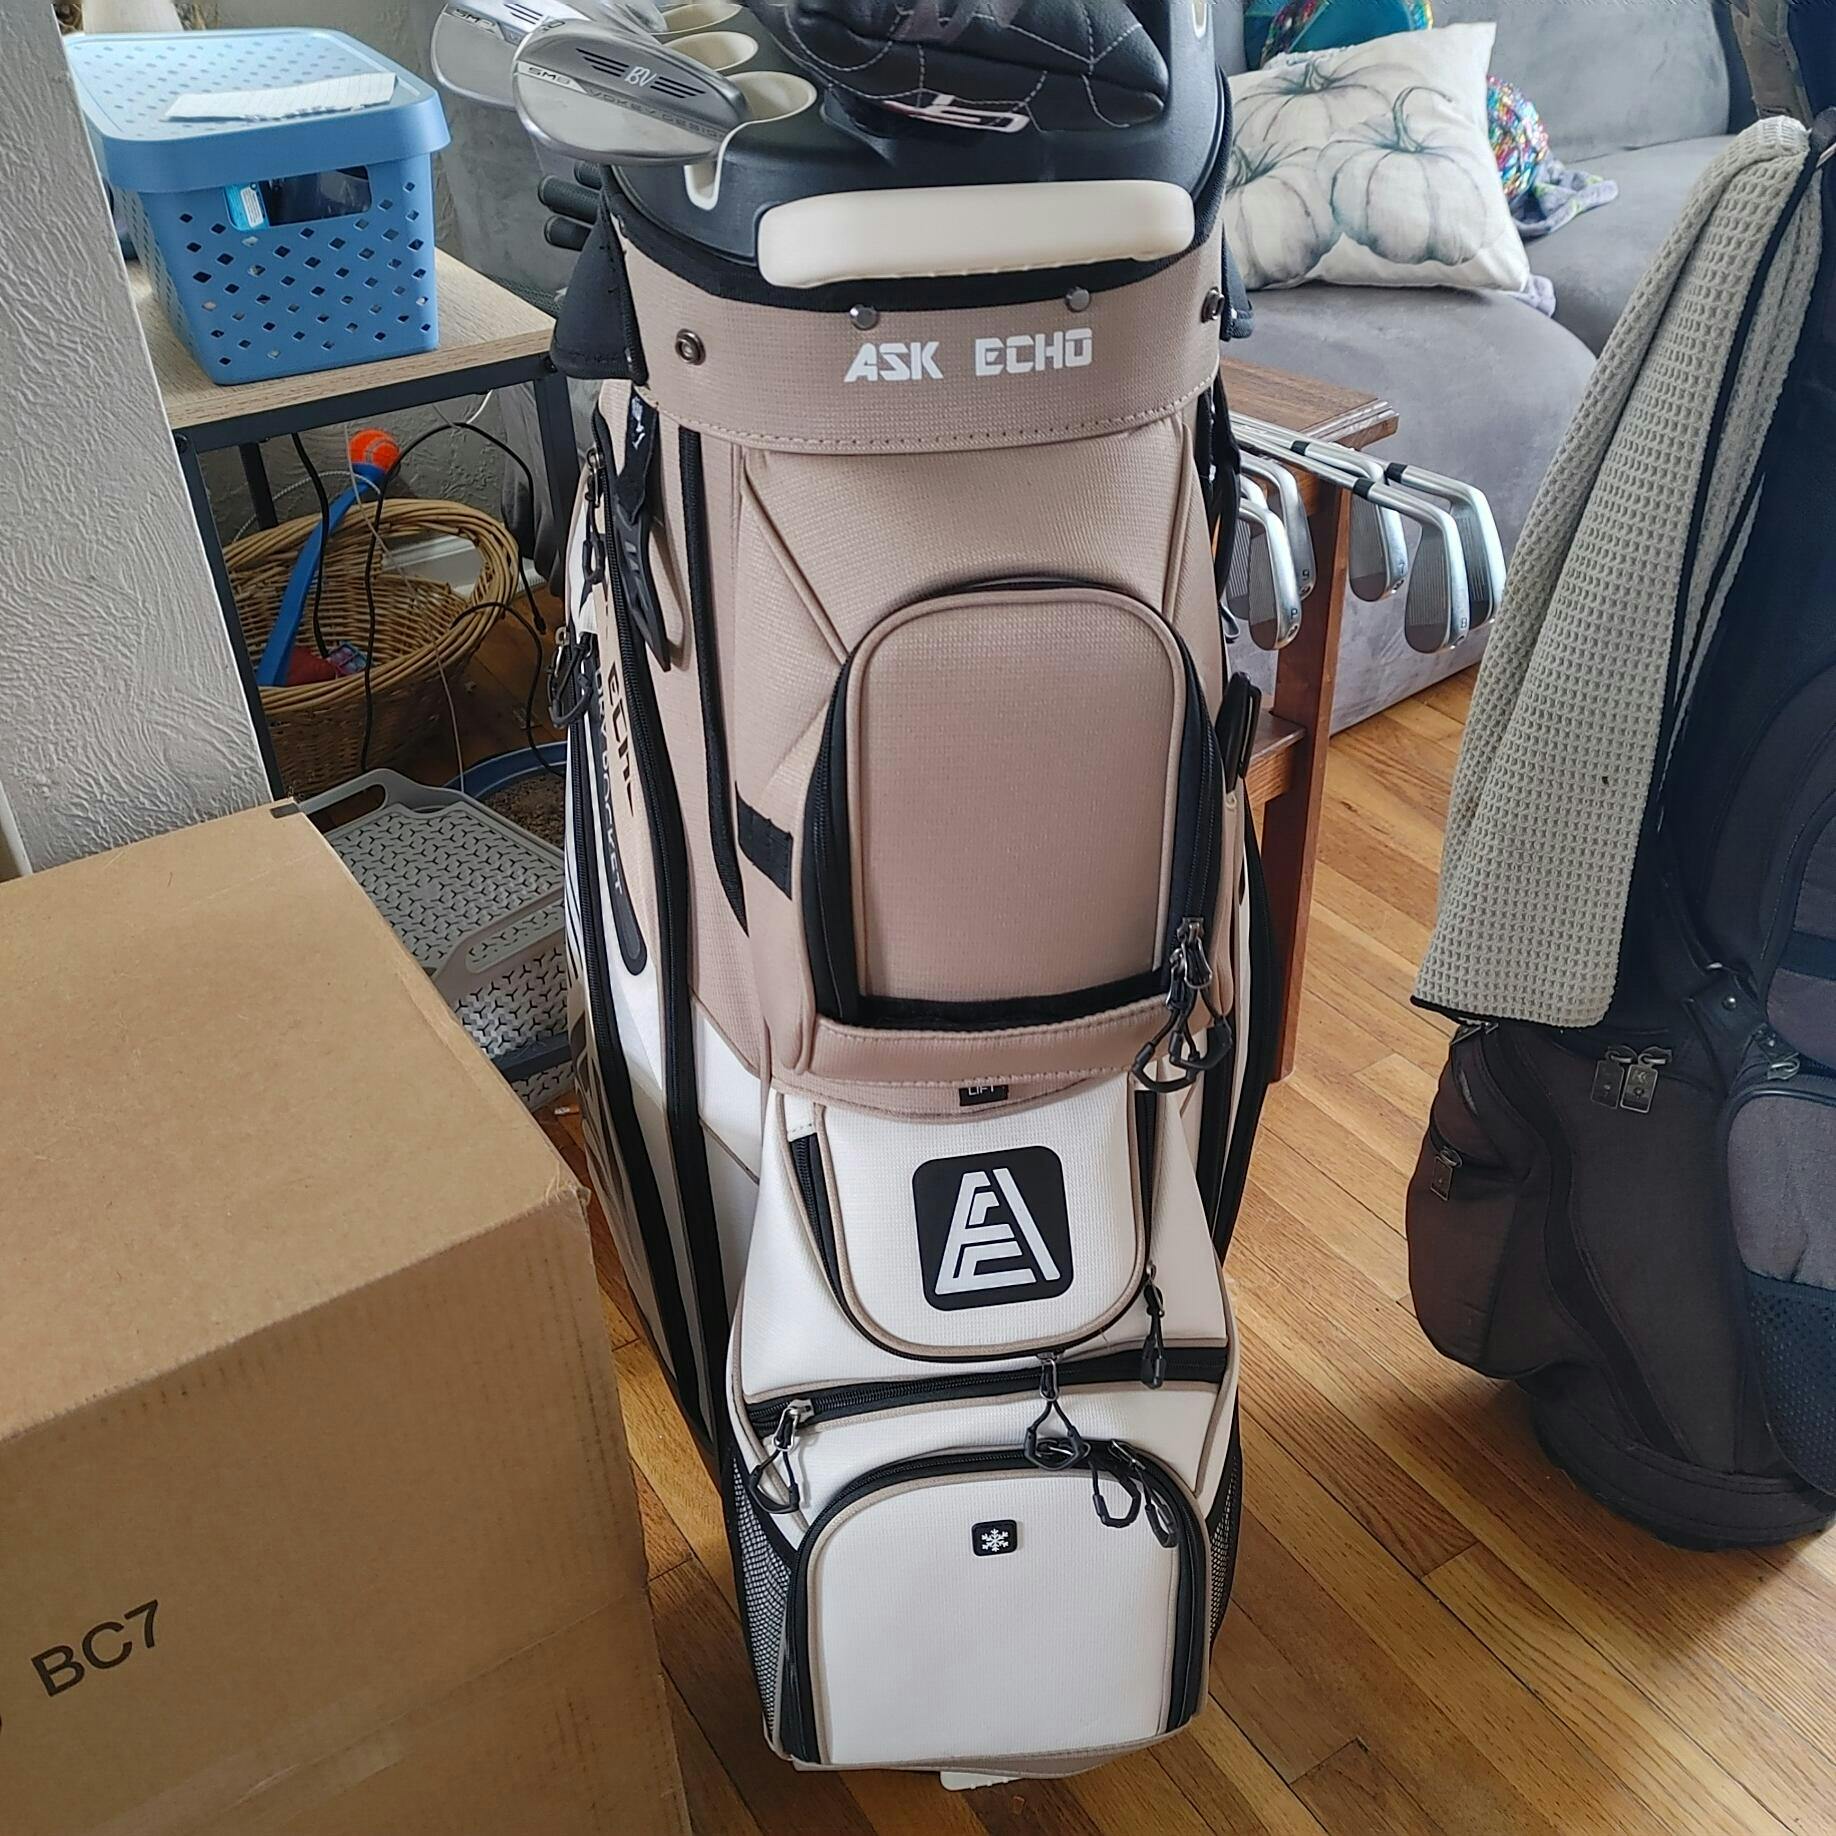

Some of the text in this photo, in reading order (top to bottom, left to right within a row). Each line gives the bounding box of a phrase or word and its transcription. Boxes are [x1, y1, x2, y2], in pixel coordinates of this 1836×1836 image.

[624, 66, 657, 87] BV
[843, 328, 1093, 383] ASK ECHO
[31, 1599, 159, 1697] BC7
